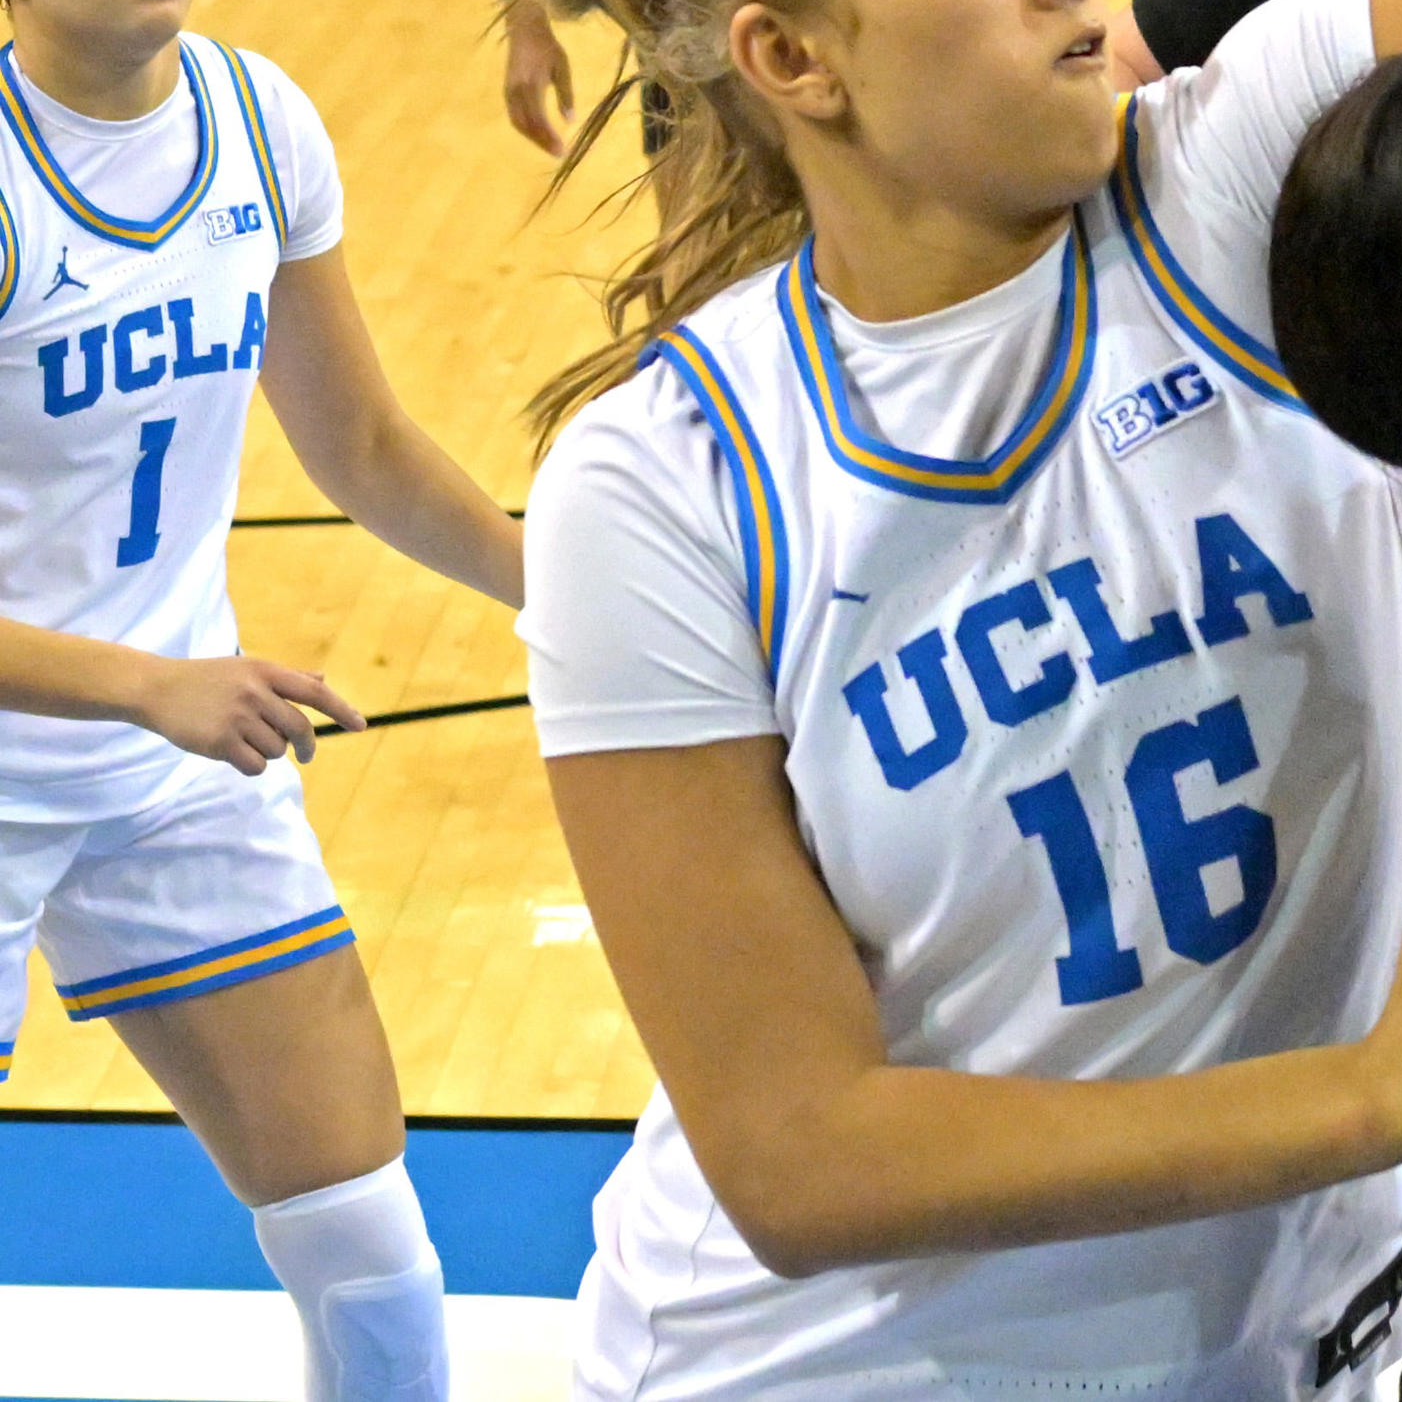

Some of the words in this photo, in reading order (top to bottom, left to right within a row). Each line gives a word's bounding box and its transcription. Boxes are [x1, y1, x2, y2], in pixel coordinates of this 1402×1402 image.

[37, 293, 267, 418] UCLA
[117, 418, 177, 567] 1
[842, 514, 1314, 791] UCLA
[1006, 697, 1277, 1006] 16
